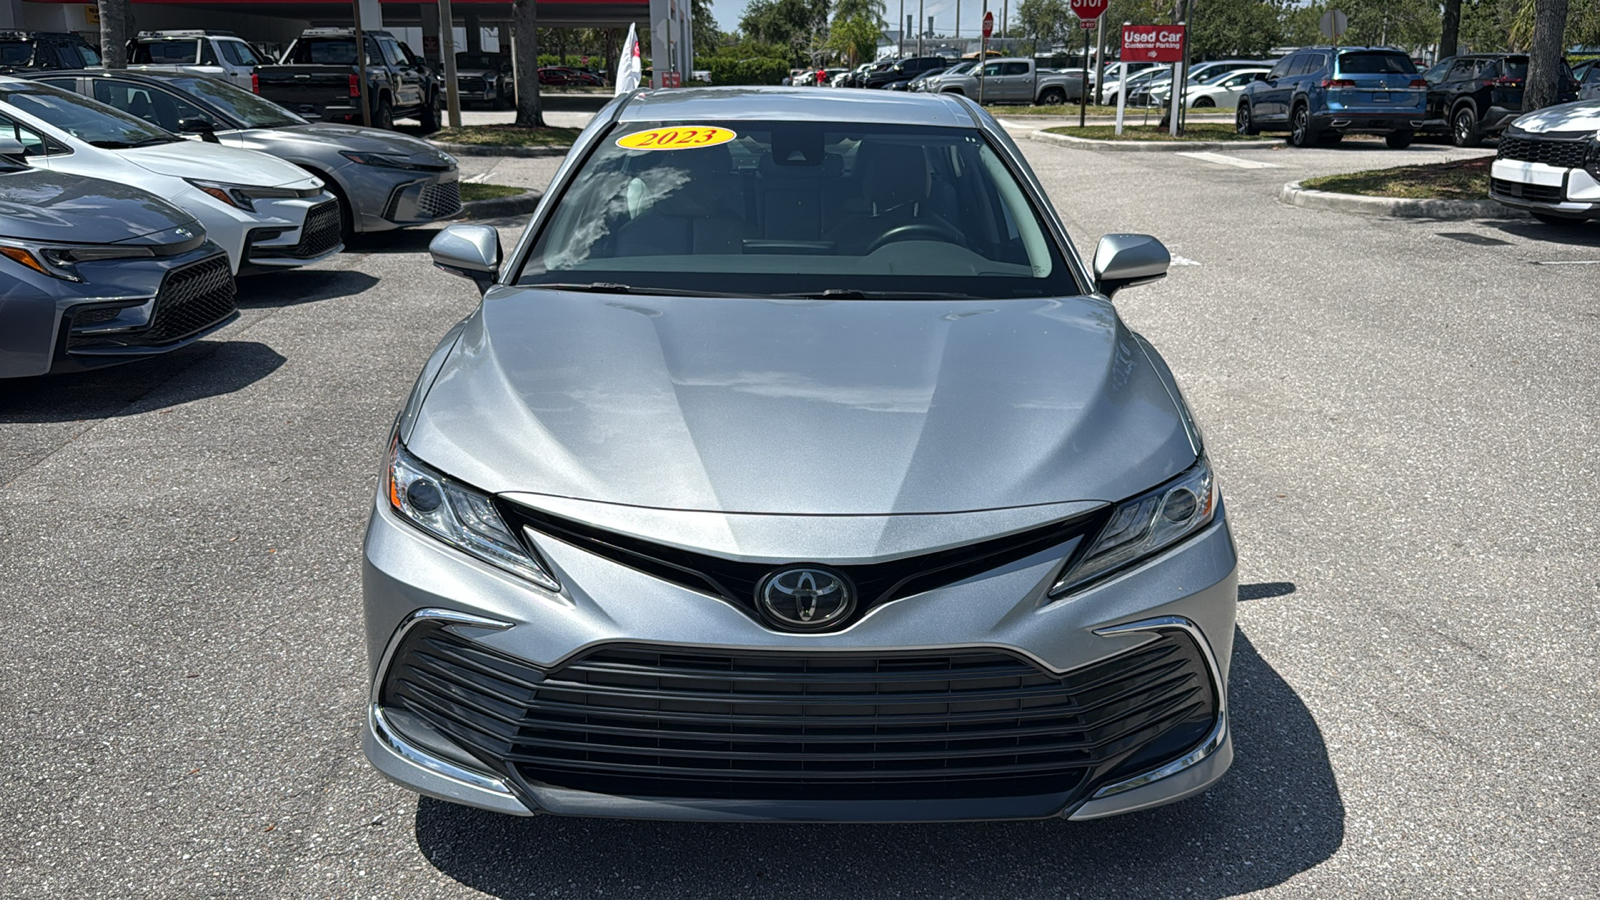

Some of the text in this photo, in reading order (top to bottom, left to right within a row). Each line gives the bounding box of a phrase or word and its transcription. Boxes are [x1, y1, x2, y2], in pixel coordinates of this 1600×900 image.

[1124, 31, 1182, 43] Used Car
[1155, 42, 1180, 50] Parking
[635, 129, 717, 147] 2023
